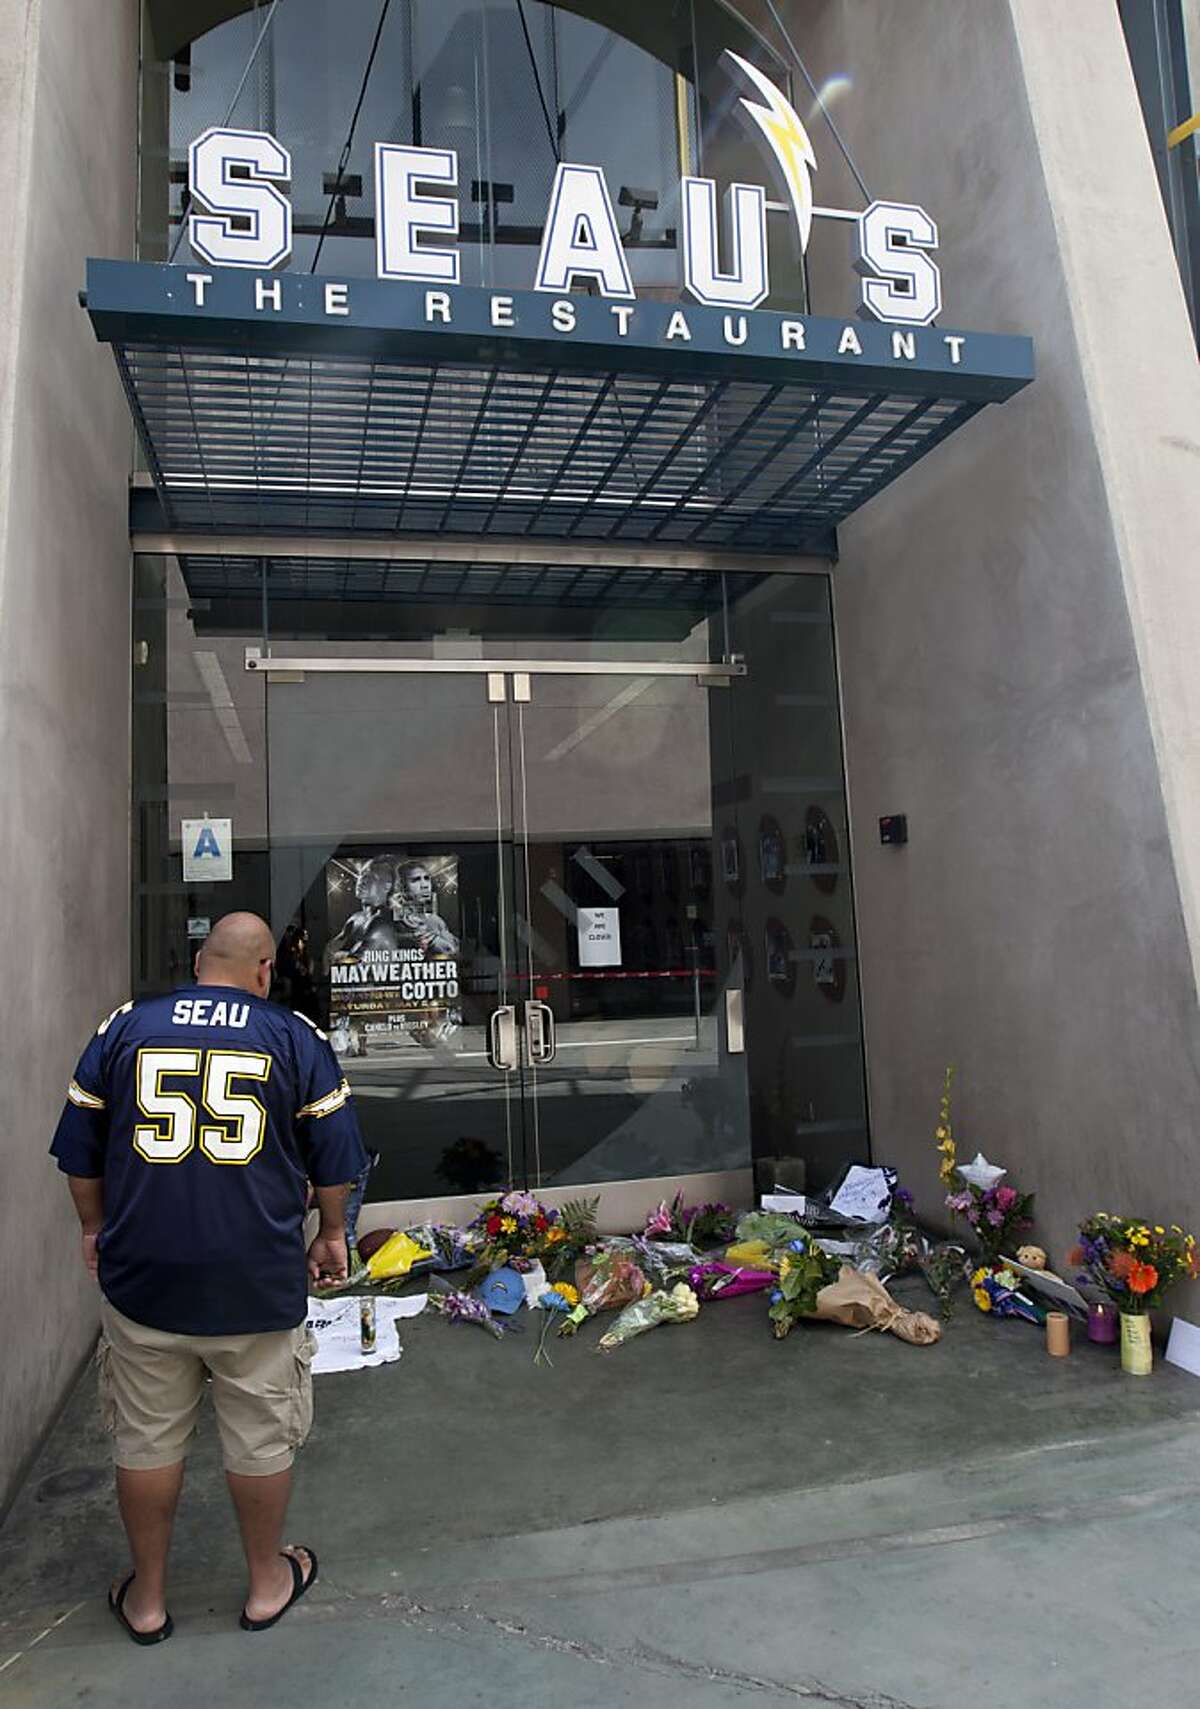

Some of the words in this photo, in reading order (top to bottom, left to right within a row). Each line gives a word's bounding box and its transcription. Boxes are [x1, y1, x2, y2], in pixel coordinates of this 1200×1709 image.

[186, 273, 350, 316] THE
[425, 291, 965, 364] RESTAURANT
[193, 827, 222, 857] A
[392, 948, 424, 961] KINGS
[331, 961, 457, 984] MAYWEATHER
[402, 981, 459, 1000] COTTO
[172, 1000, 250, 1028] SEAU
[133, 1048, 272, 1165] 55
